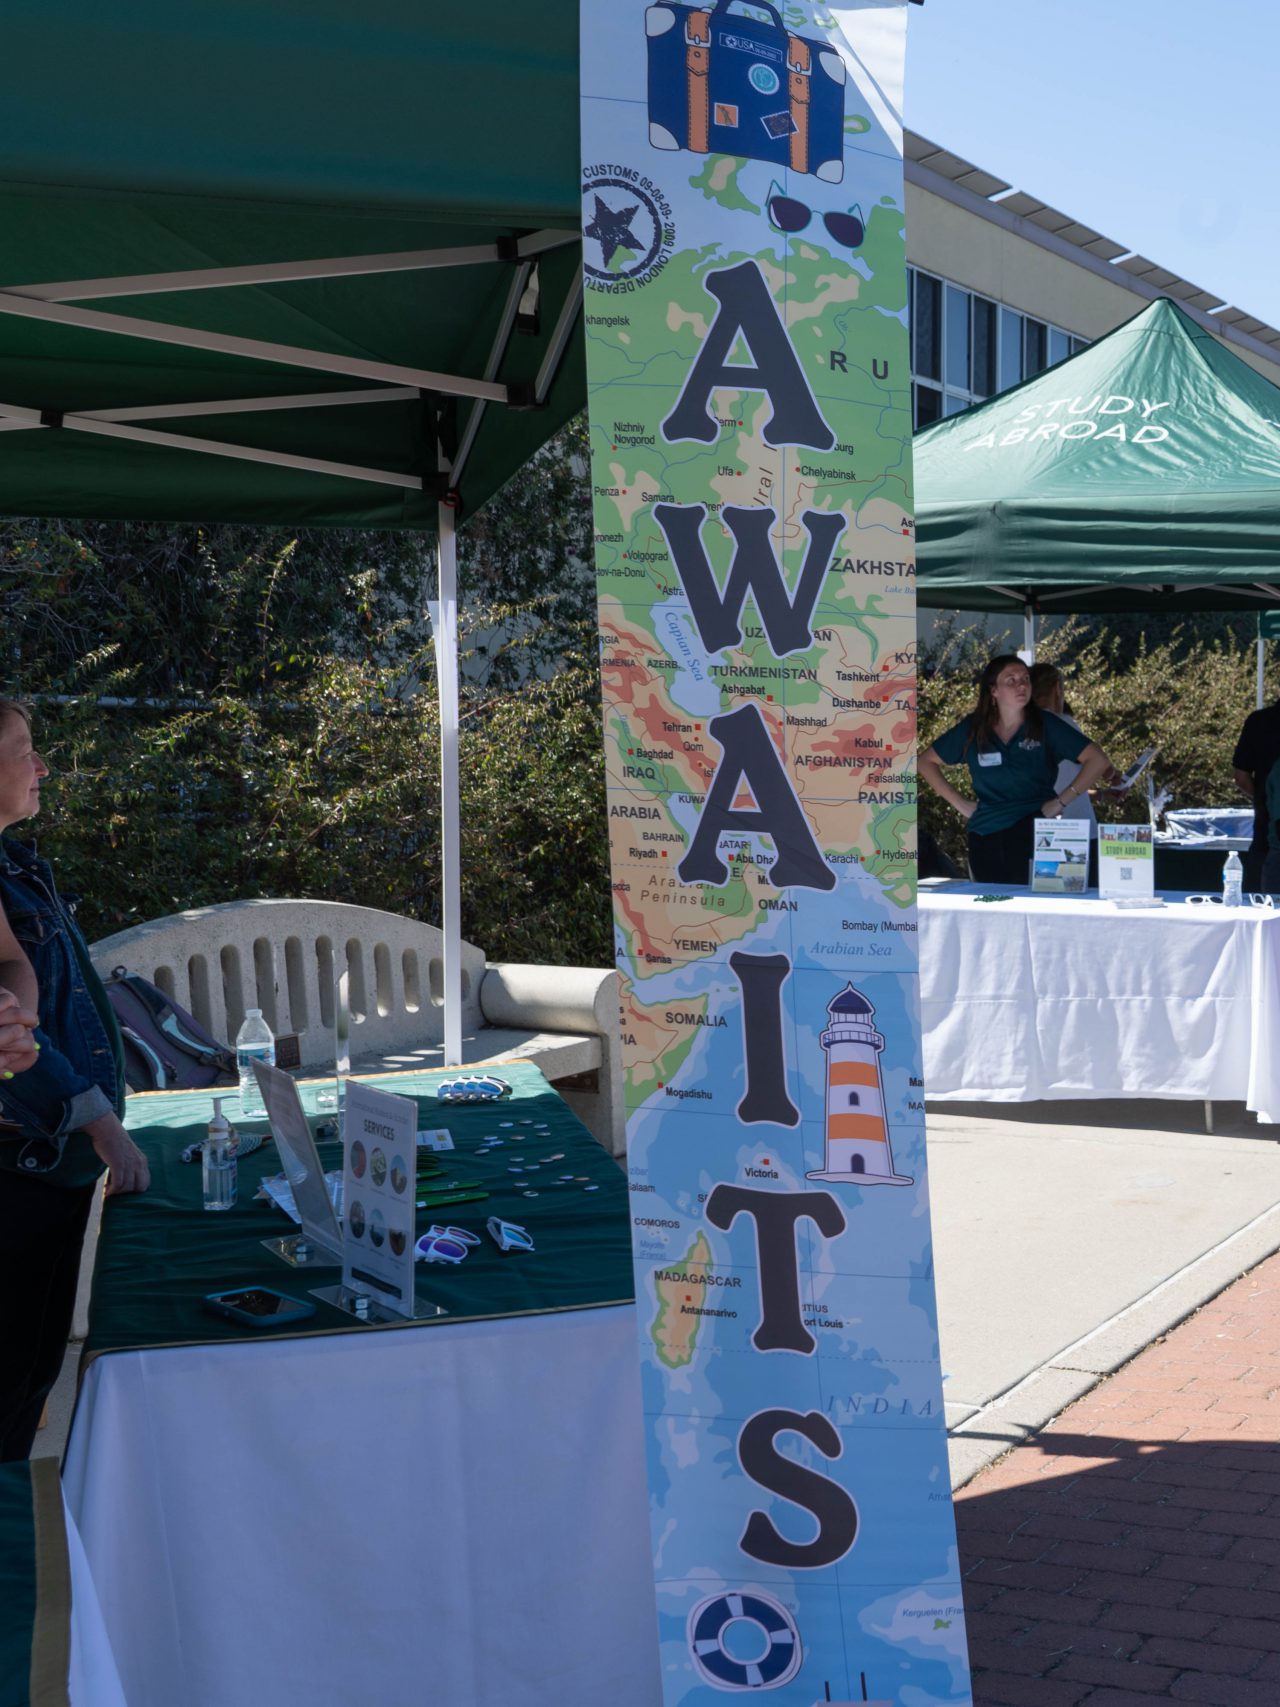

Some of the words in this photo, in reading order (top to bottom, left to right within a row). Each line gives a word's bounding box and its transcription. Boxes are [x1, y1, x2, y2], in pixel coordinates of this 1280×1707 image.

[737, 39, 755, 52] USA
[583, 164, 640, 182] CUSTOMS
[664, 222, 676, 248] 2009
[636, 248, 673, 288] LONDON
[1013, 394, 1170, 424] STUDY
[613, 422, 645, 435] Nizhniy
[614, 434, 656, 446] Novgorod
[963, 420, 1170, 452] ABROAD
[717, 465, 734, 477] Ufa
[801, 466, 857, 481] Chelyabinsk
[594, 486, 620, 497] Penza
[641, 491, 675, 503] Samara
[627, 550, 669, 563] Volgograd
[647, 659, 681, 669] AZERB.
[686, 658, 704, 682] Sea
[711, 664, 818, 681] TURKMENISTAN
[835, 670, 880, 683] Tashkent
[720, 683, 766, 697] Ashgabat
[832, 697, 881, 709] Dushanbe
[662, 721, 692, 733] Tehran
[786, 716, 828, 728] Mashhad
[682, 741, 704, 752] Qom
[854, 737, 883, 749] Kabul
[636, 748, 674, 760] Baghdad
[795, 755, 893, 769] AFGHANISTAN
[622, 766, 656, 780] IRAQ
[610, 805, 662, 820] ARABIA
[642, 832, 685, 842] BAHRAIN
[629, 847, 658, 860] Riyadh
[1106, 845, 1122, 856] STUDY
[1124, 845, 1147, 856] ABROAD
[735, 853, 753, 864] Abu
[825, 853, 859, 864] Karachi
[640, 889, 726, 907] Peninsula
[758, 899, 798, 912] OMAN
[842, 920, 878, 933] Bombay
[673, 939, 718, 953] YEMEN
[810, 941, 864, 956] Arabian
[867, 943, 892, 956] Sea
[645, 953, 672, 965] Sanaa
[665, 1012, 728, 1028] SOMALIA
[665, 1087, 713, 1100] Mogadishu
[363, 1119, 395, 1141] SERVICES
[744, 1167, 779, 1180] Victoria
[634, 1217, 681, 1229] COMOROS
[654, 1270, 742, 1288] MADAGASCAR
[680, 1304, 738, 1319] Antananarivo
[818, 1318, 844, 1329] Louis
[902, 1607, 943, 1619] Kerguelen
